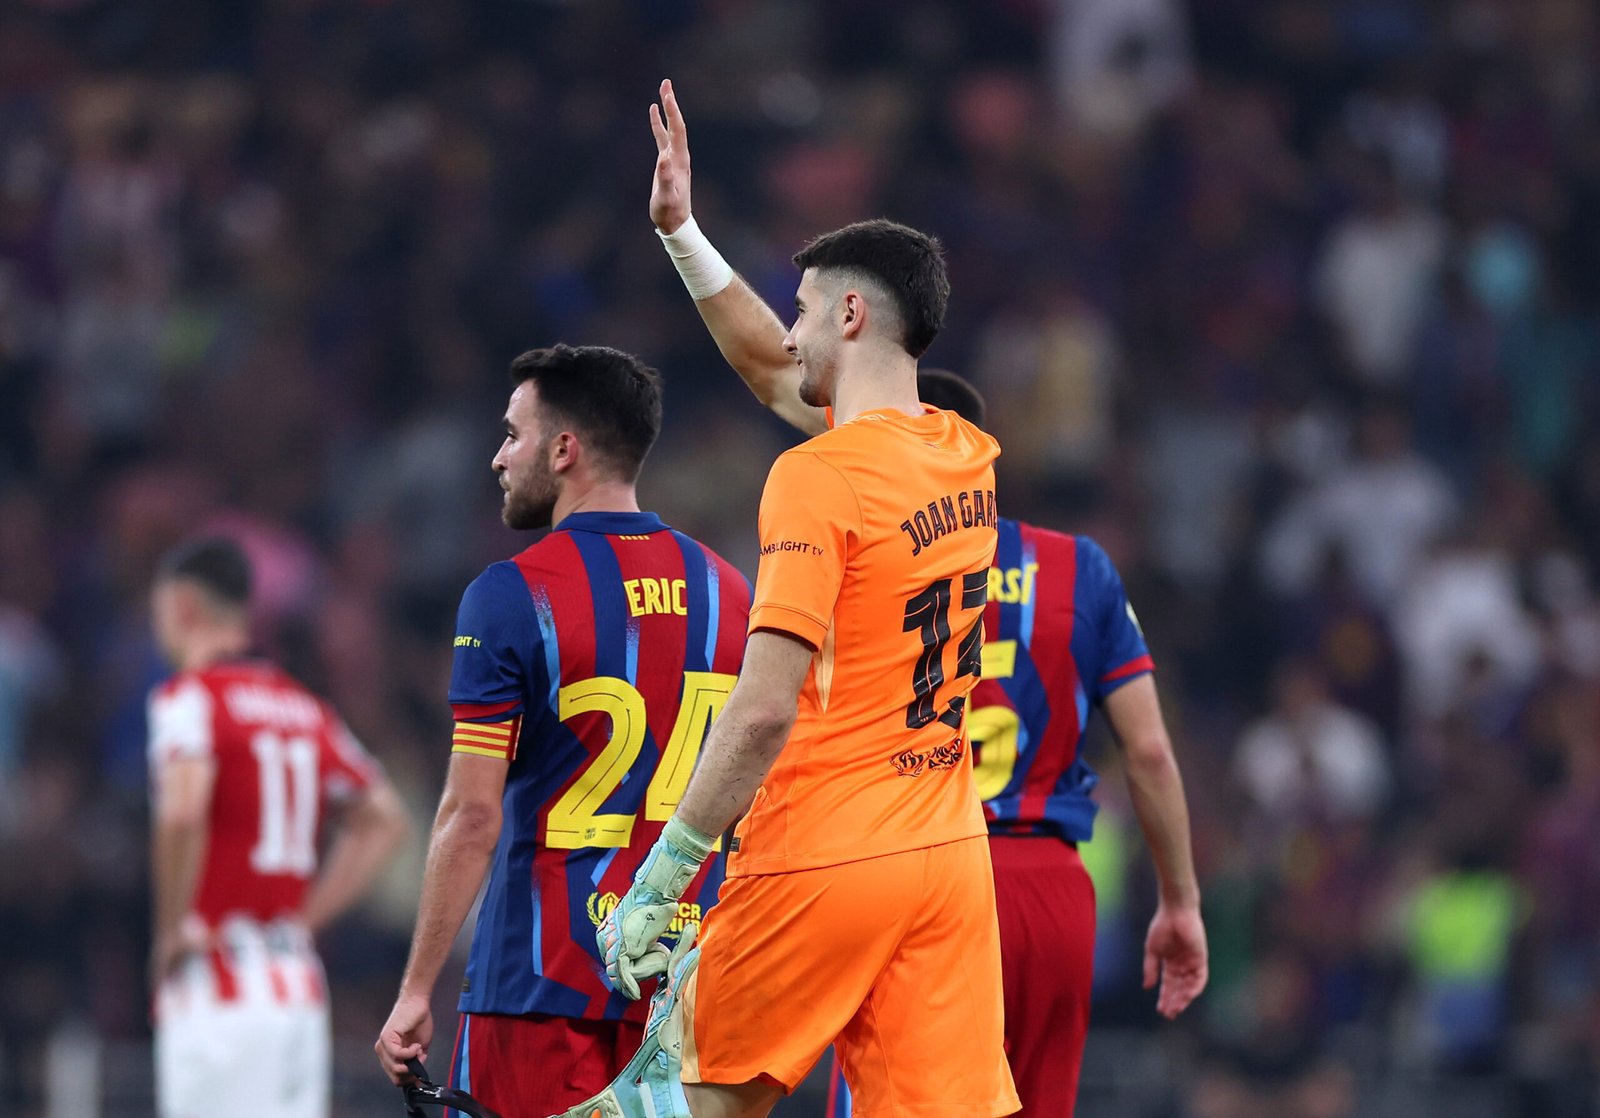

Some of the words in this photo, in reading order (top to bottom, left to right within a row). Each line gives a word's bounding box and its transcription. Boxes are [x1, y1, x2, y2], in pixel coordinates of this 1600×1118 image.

[812, 545, 824, 555] tv
[900, 496, 958, 556] JOAN
[958, 490, 997, 529] GAR
[624, 578, 688, 617] ERIC
[546, 671, 738, 852] 24
[252, 733, 317, 874] 11
